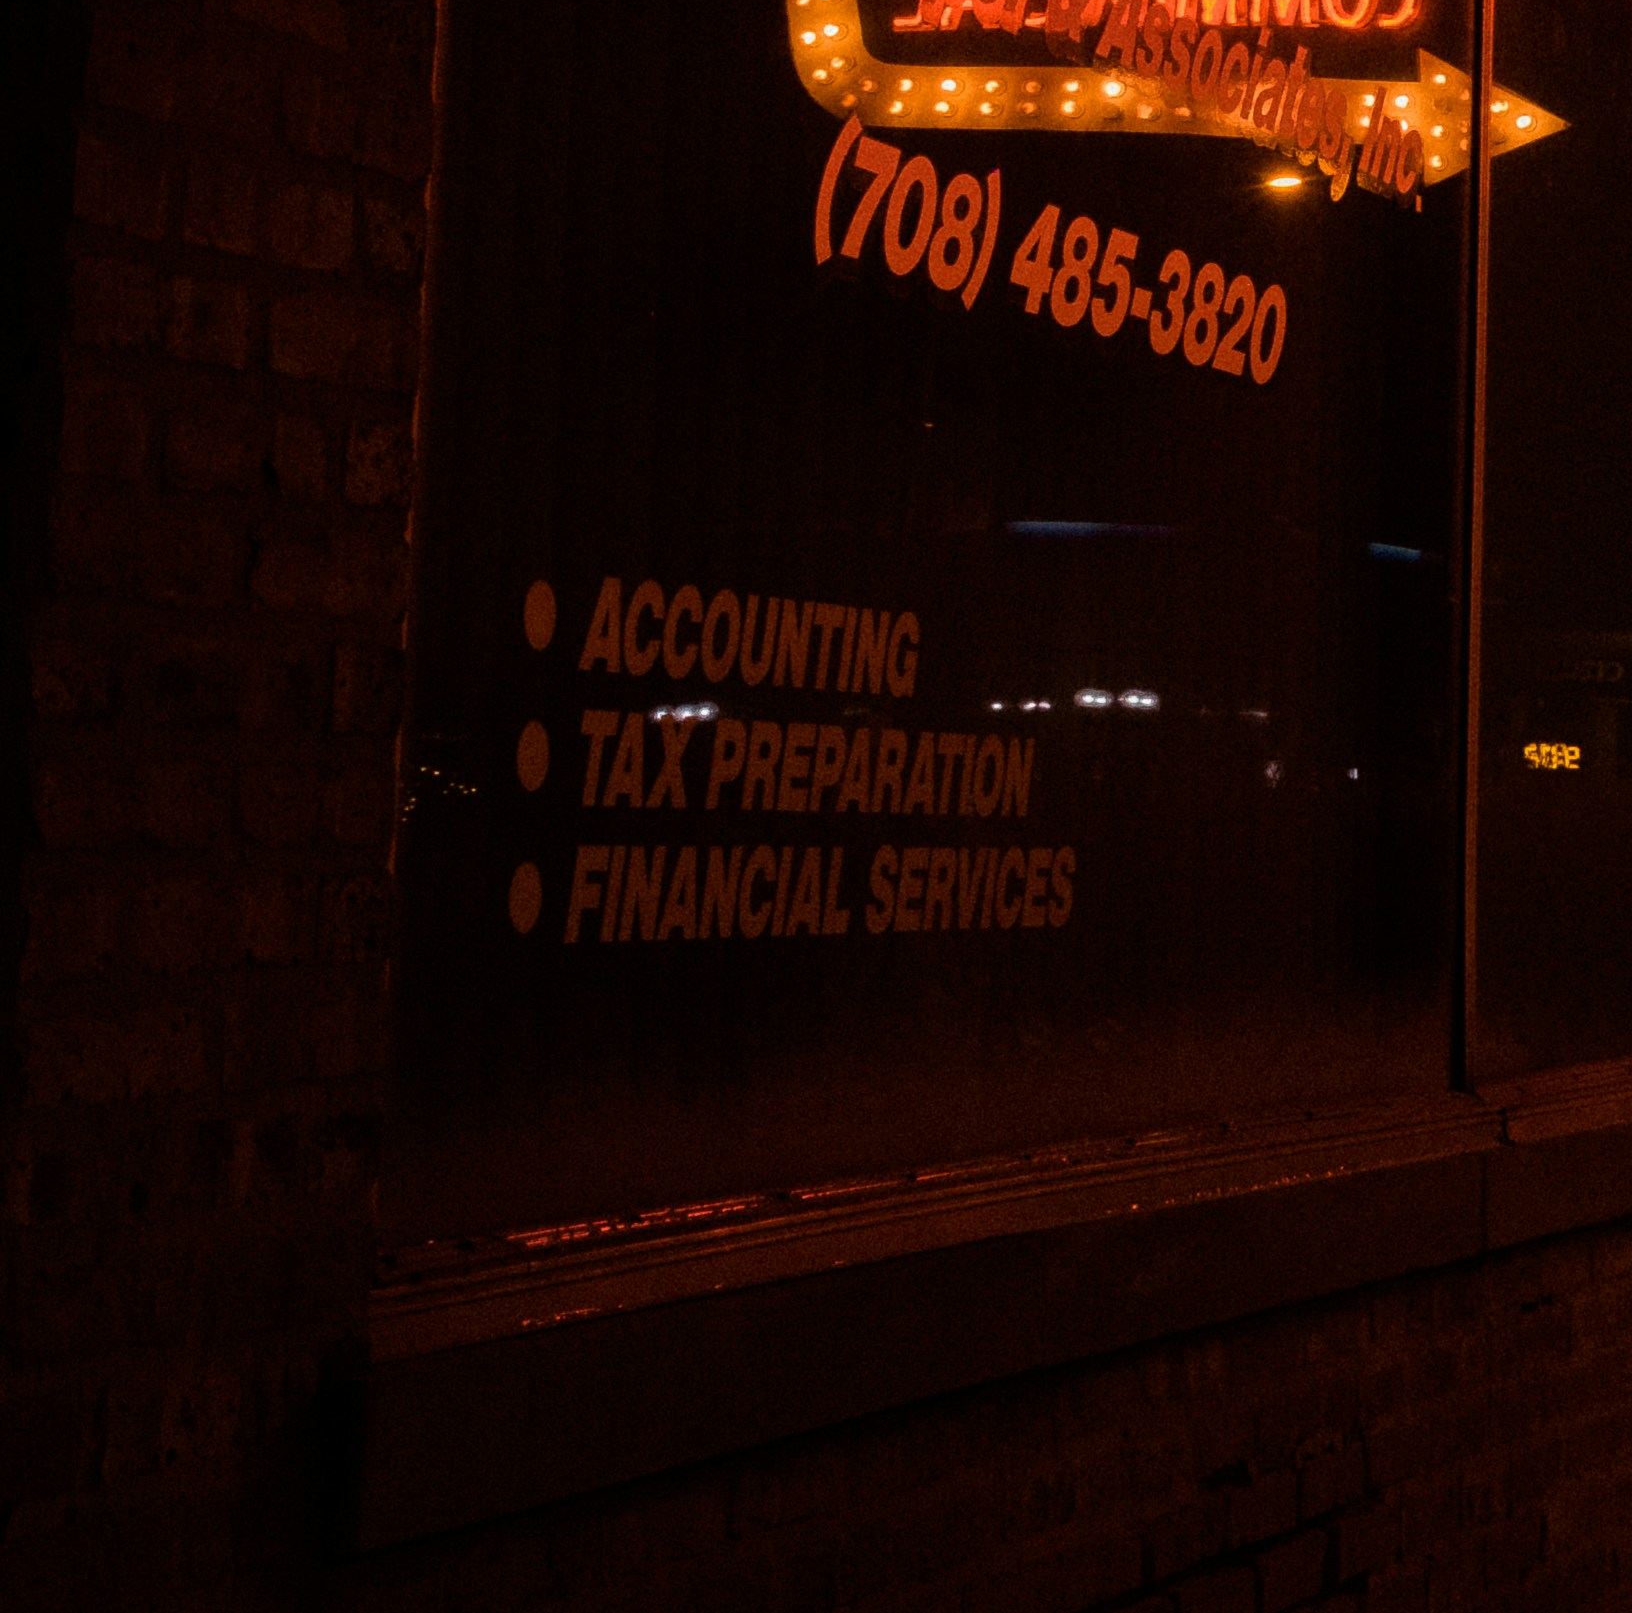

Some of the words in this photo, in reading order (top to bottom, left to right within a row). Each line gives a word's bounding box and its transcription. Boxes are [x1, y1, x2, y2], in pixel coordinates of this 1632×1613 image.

[814, 113, 1001, 312] (708)
[1009, 202, 1287, 386] 485-3820
[578, 576, 921, 698] ACCOUNTING
[580, 708, 697, 810] TAX
[705, 717, 1036, 818] PREPARATION
[563, 843, 852, 944] FINANCIAL
[865, 843, 1078, 935] SERVICES
